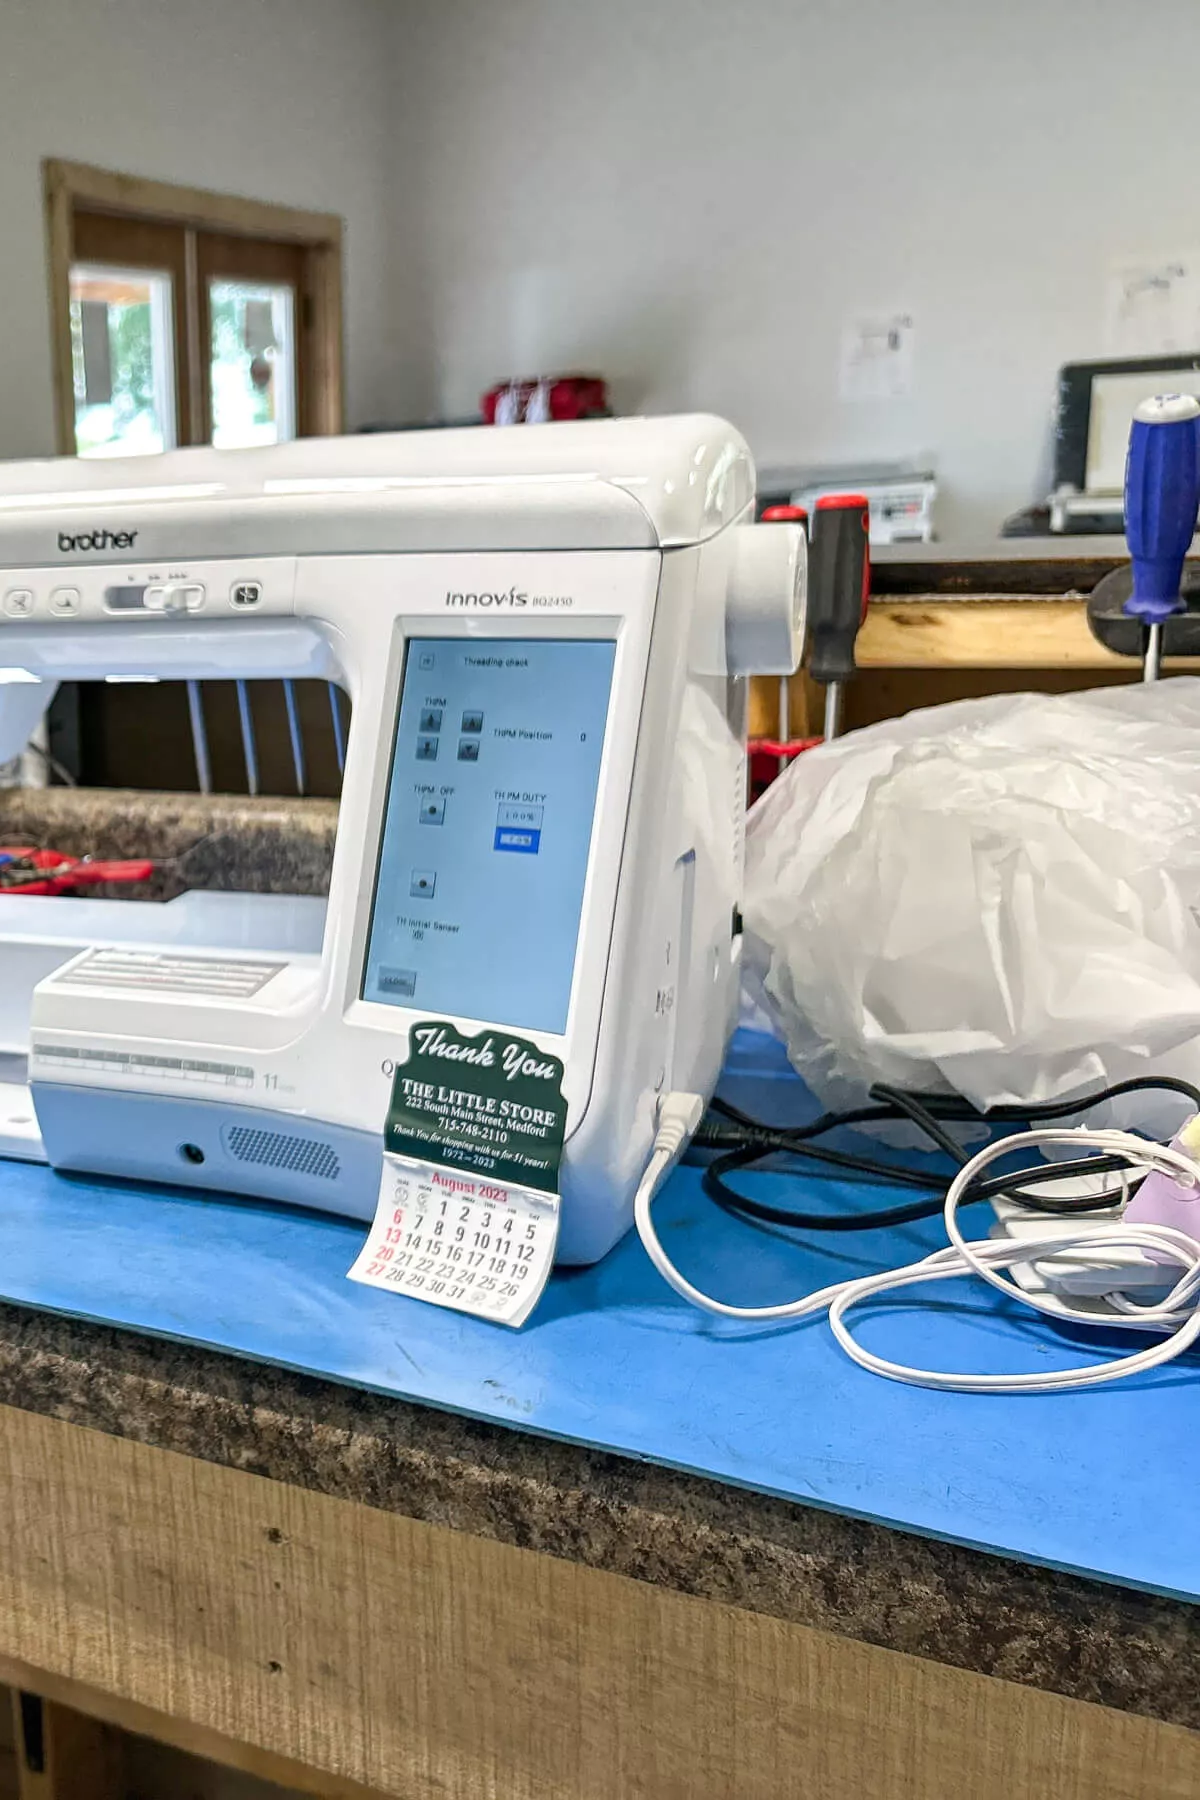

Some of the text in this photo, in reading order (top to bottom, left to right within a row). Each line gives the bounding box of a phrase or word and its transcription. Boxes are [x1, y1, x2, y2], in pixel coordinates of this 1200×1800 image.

[57, 528, 138, 552] brother
[464, 657, 528, 668] Threading check
[518, 730, 553, 741] Position
[415, 1027, 556, 1081] Thank You
[401, 1078, 557, 1127] THE LITTLE STORE
[405, 1096, 547, 1138] 222 South Main Street, Medford
[393, 1124, 415, 1137] Thank
[415, 1128, 430, 1140] You
[429, 1130, 441, 1143] for
[442, 1134, 475, 1152] shopping
[475, 1143, 492, 1155] with
[491, 1148, 501, 1158] us
[501, 1150, 513, 1162] for
[523, 1156, 550, 1170] years!
[438, 1116, 508, 1144] 715-748-2110
[432, 1171, 508, 1203] August 2023
[393, 1209, 535, 1262] 6 7 8 9 10 11 12
[440, 1200, 536, 1240] 1 2 3 4 5
[375, 1245, 520, 1297] 20 21 22 23 24 25 26
[385, 1227, 529, 1281] 13 14 15 16 17 18 19
[365, 1261, 466, 1300] 27 28 29 30 31
